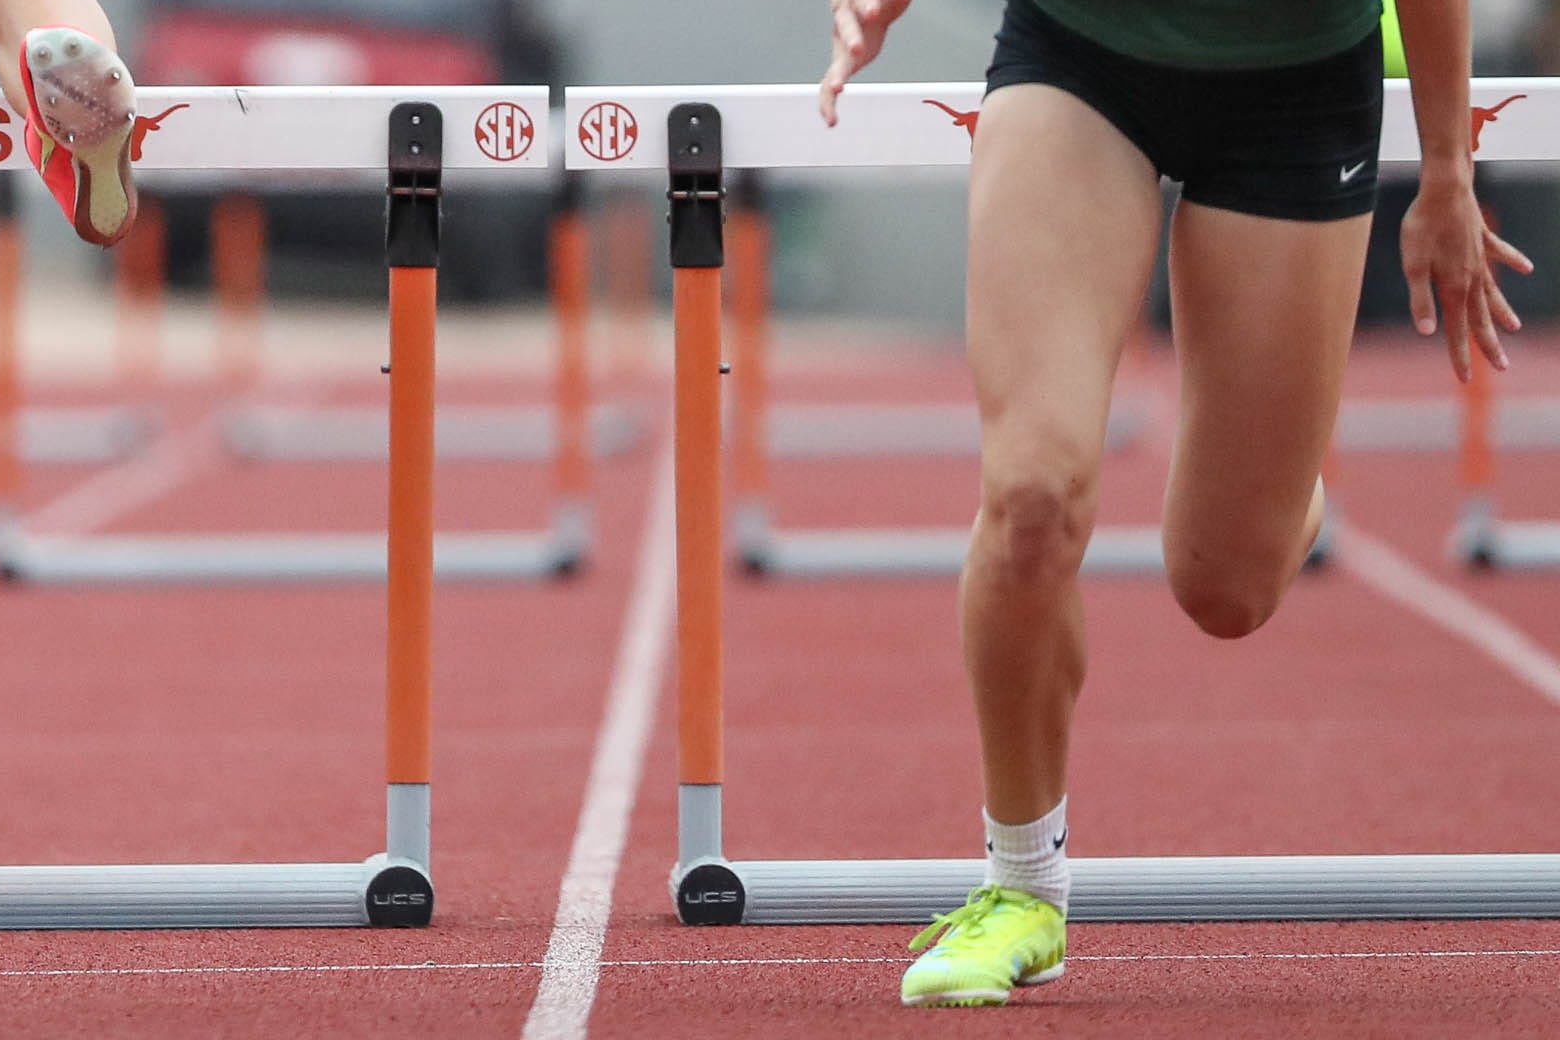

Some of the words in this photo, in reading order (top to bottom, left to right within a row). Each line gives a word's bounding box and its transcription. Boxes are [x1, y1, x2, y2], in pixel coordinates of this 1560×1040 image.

[478, 105, 531, 158] SEC
[581, 105, 635, 158] SEC
[373, 892, 426, 905] UCS
[684, 891, 737, 904] UCS
